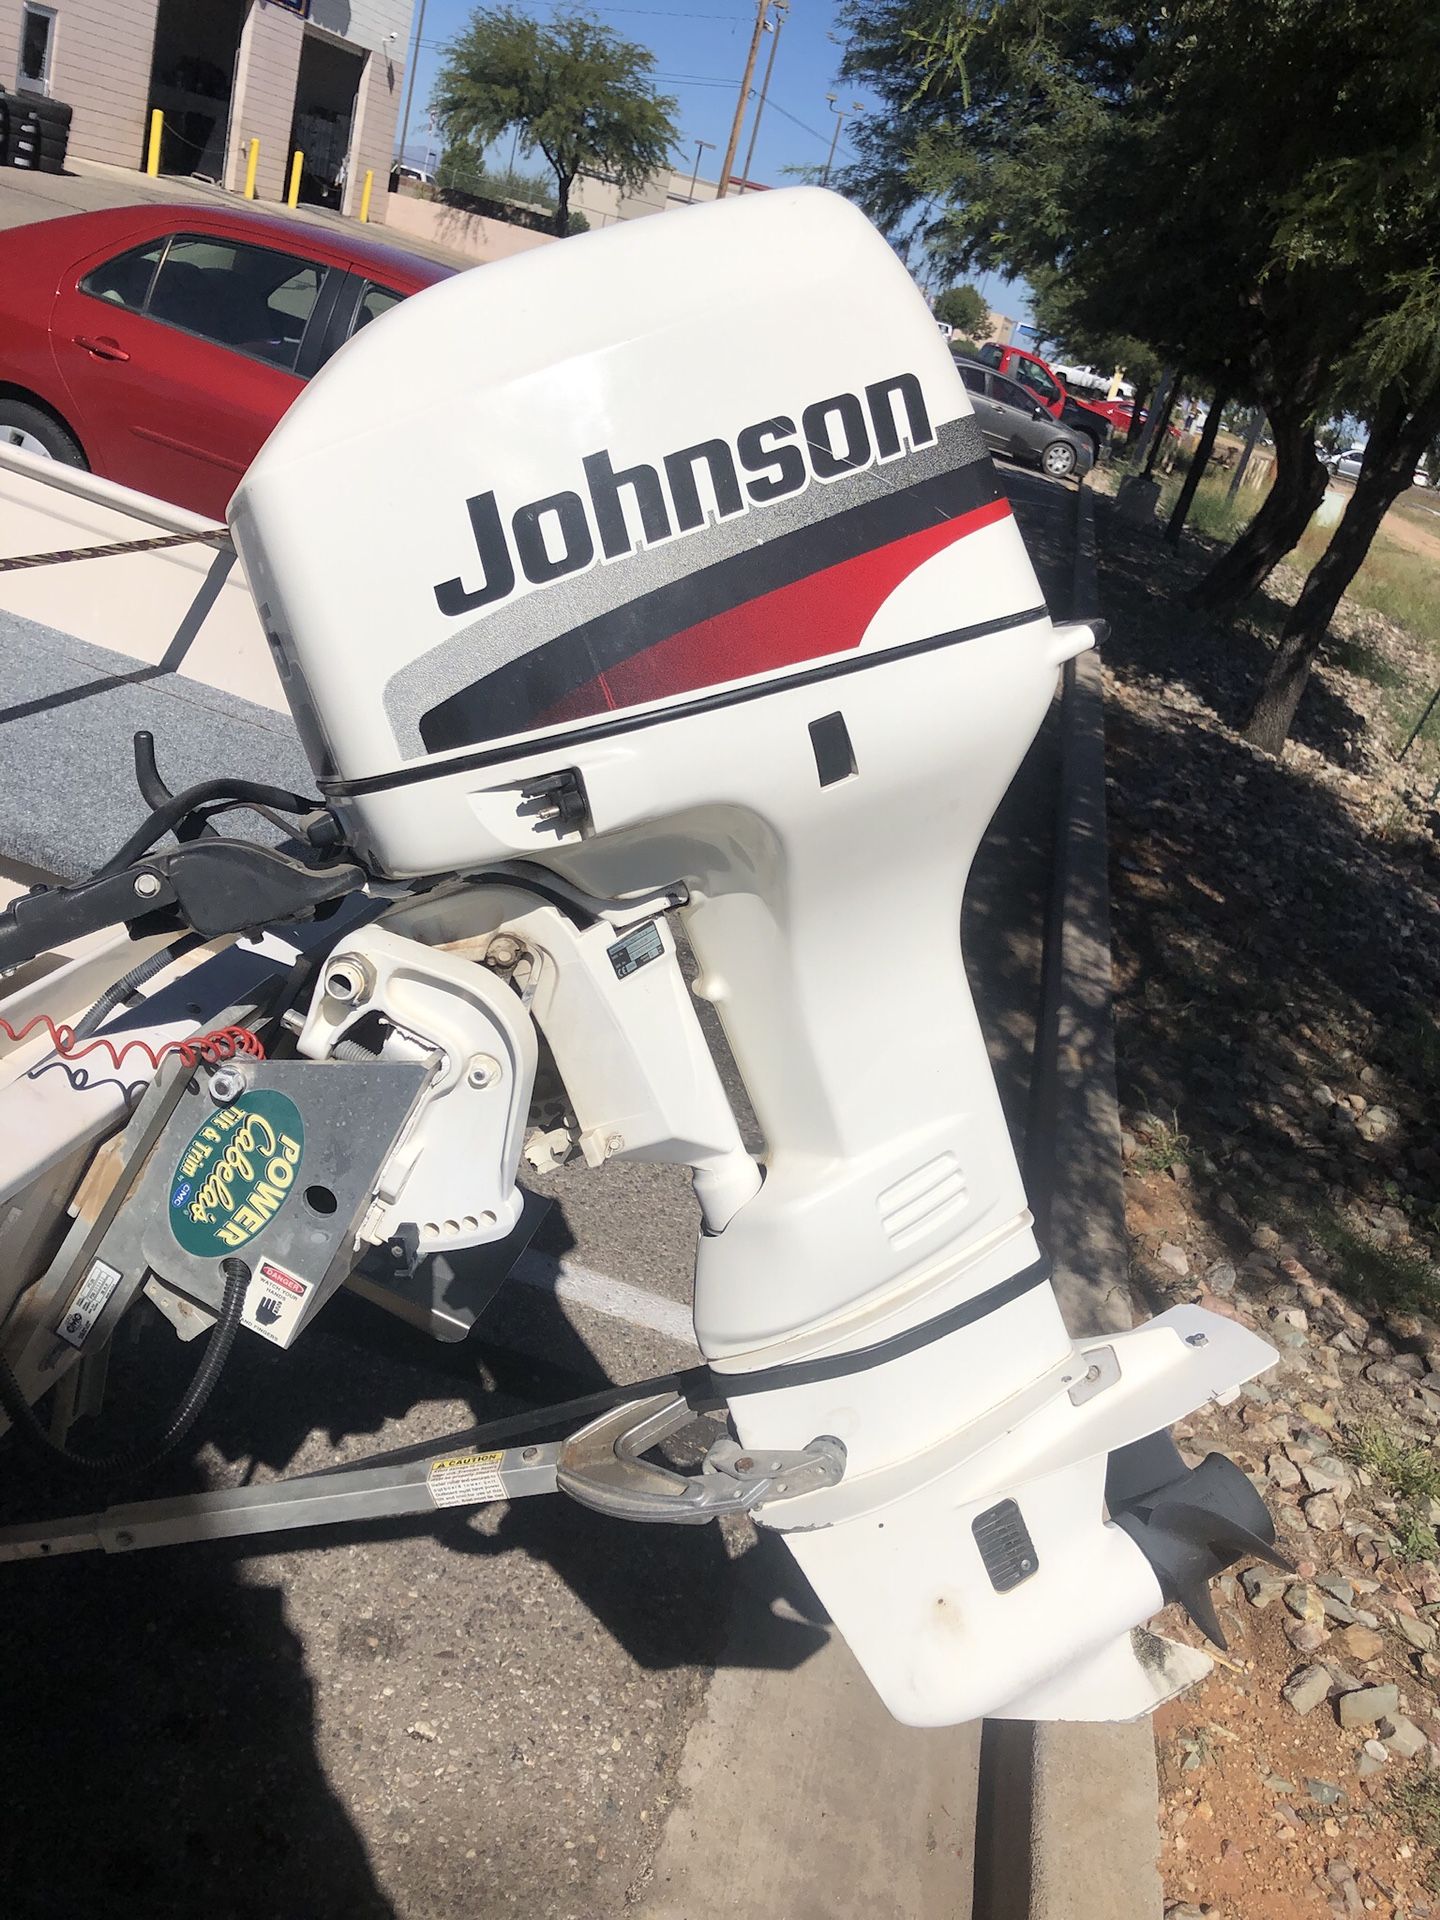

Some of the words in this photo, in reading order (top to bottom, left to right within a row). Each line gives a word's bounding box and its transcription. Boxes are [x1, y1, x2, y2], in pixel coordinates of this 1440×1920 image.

[433, 372, 935, 617] Johnson
[211, 1105, 247, 1131] Tilt
[199, 1127, 221, 1143] &
[180, 1140, 214, 1178] Trim
[188, 1113, 276, 1225] Cabela's
[173, 1184, 191, 1207] CMC
[213, 1132, 301, 1246] POWER
[260, 1277, 281, 1292] WATCH
[282, 1289, 298, 1301] YOUR
[265, 1267, 300, 1293] DANGER
[266, 1287, 286, 1301] HANDS
[241, 1317, 253, 1327] AND
[253, 1324, 279, 1341] FINGERS
[448, 1454, 497, 1466] CAUTION
